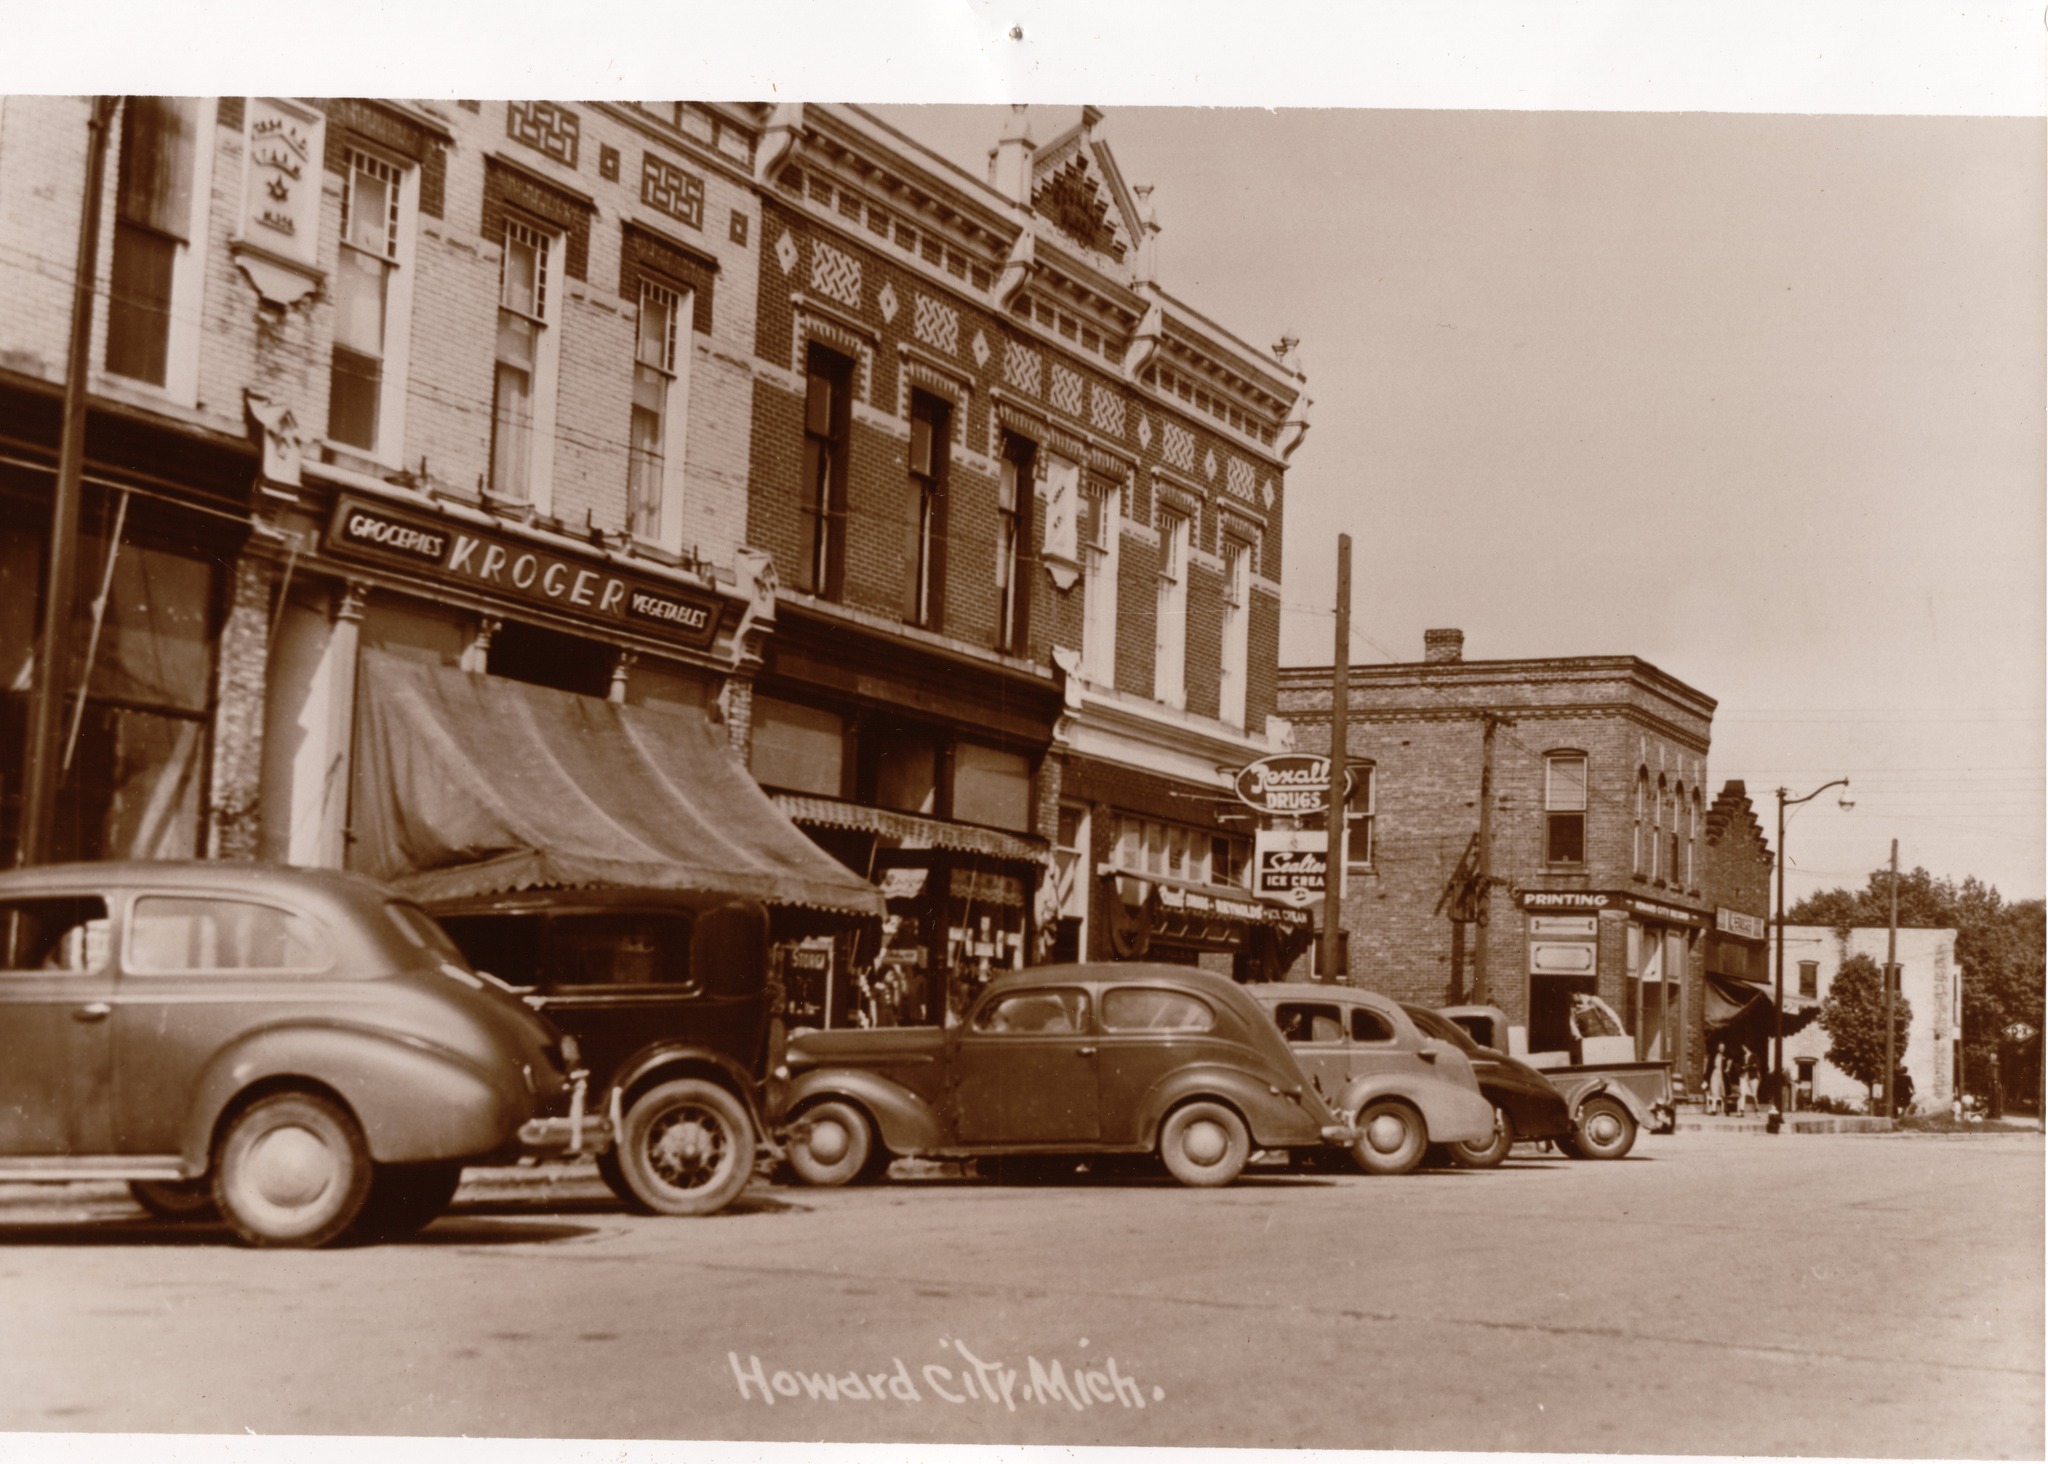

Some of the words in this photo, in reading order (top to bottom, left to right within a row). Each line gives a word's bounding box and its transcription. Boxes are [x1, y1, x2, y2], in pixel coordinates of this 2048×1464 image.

[350, 515, 444, 557] GROCERIES
[448, 535, 625, 614] KROGER
[632, 593, 707, 628] VEGETABLES
[1250, 762, 1331, 794] Rexall
[1266, 793, 1322, 809] DRUGS
[1269, 853, 1327, 874] Sealtes
[1266, 876, 1288, 886] ICE
[1291, 876, 1325, 886] CREA
[1524, 893, 1609, 907] PRINTING
[1657, 906, 1669, 916] CITY
